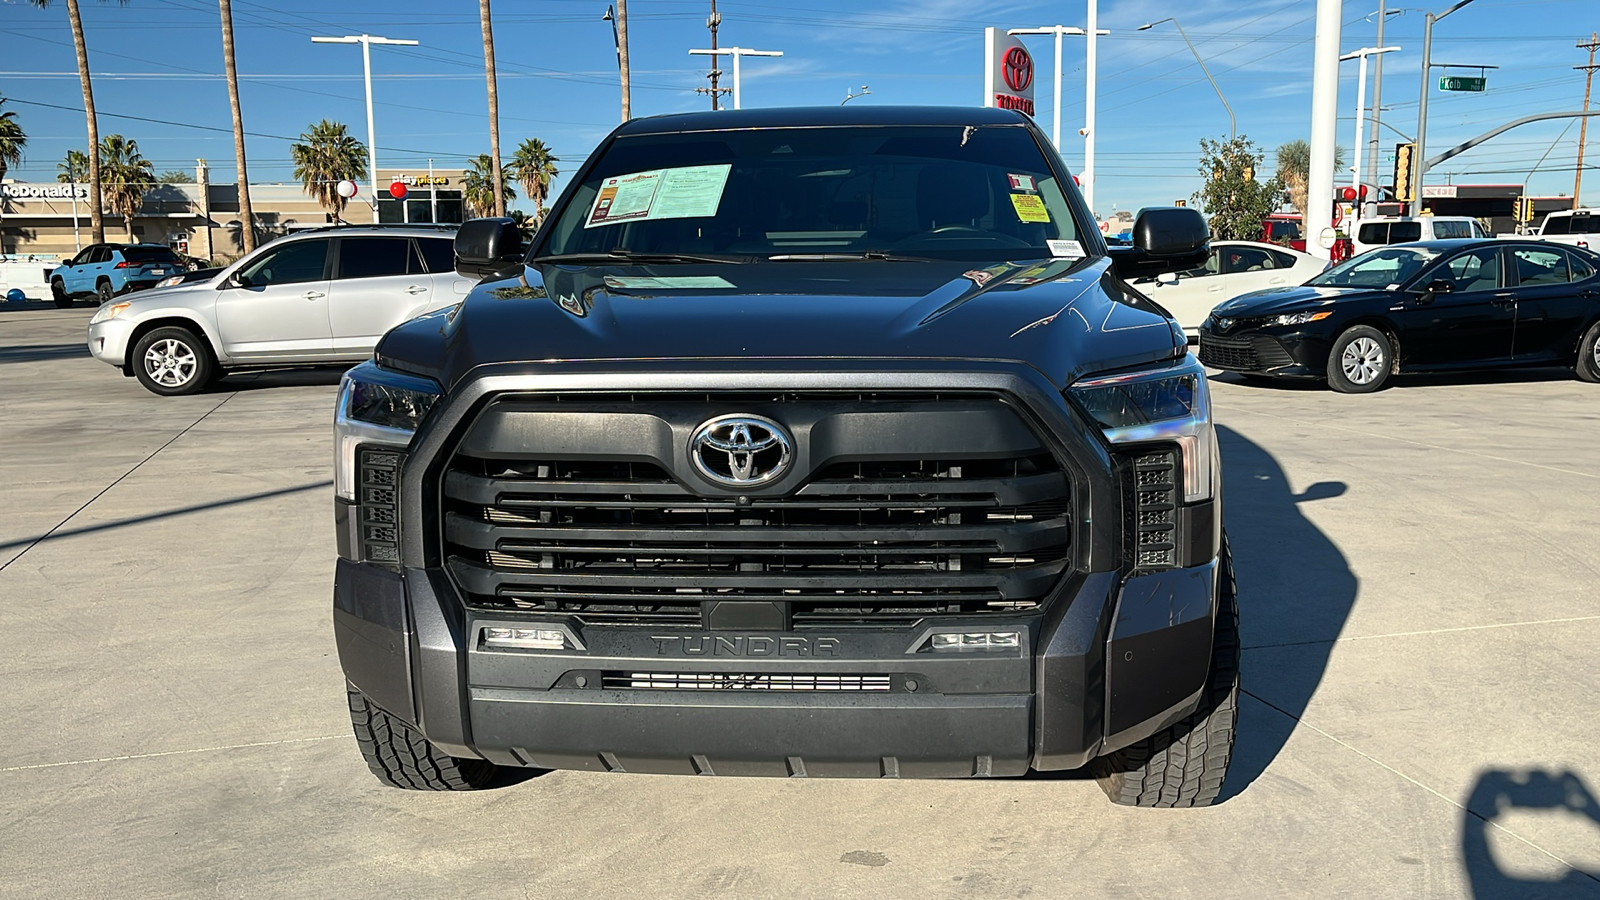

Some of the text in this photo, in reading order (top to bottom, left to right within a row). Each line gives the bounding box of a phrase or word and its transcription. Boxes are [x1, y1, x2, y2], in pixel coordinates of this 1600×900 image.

[1444, 78, 1462, 90] Kolb
[995, 94, 1035, 117] TOYOTA
[391, 173, 447, 188] playplace
[2, 184, 86, 199] McDonalds
[650, 636, 841, 657] TUNDRA
